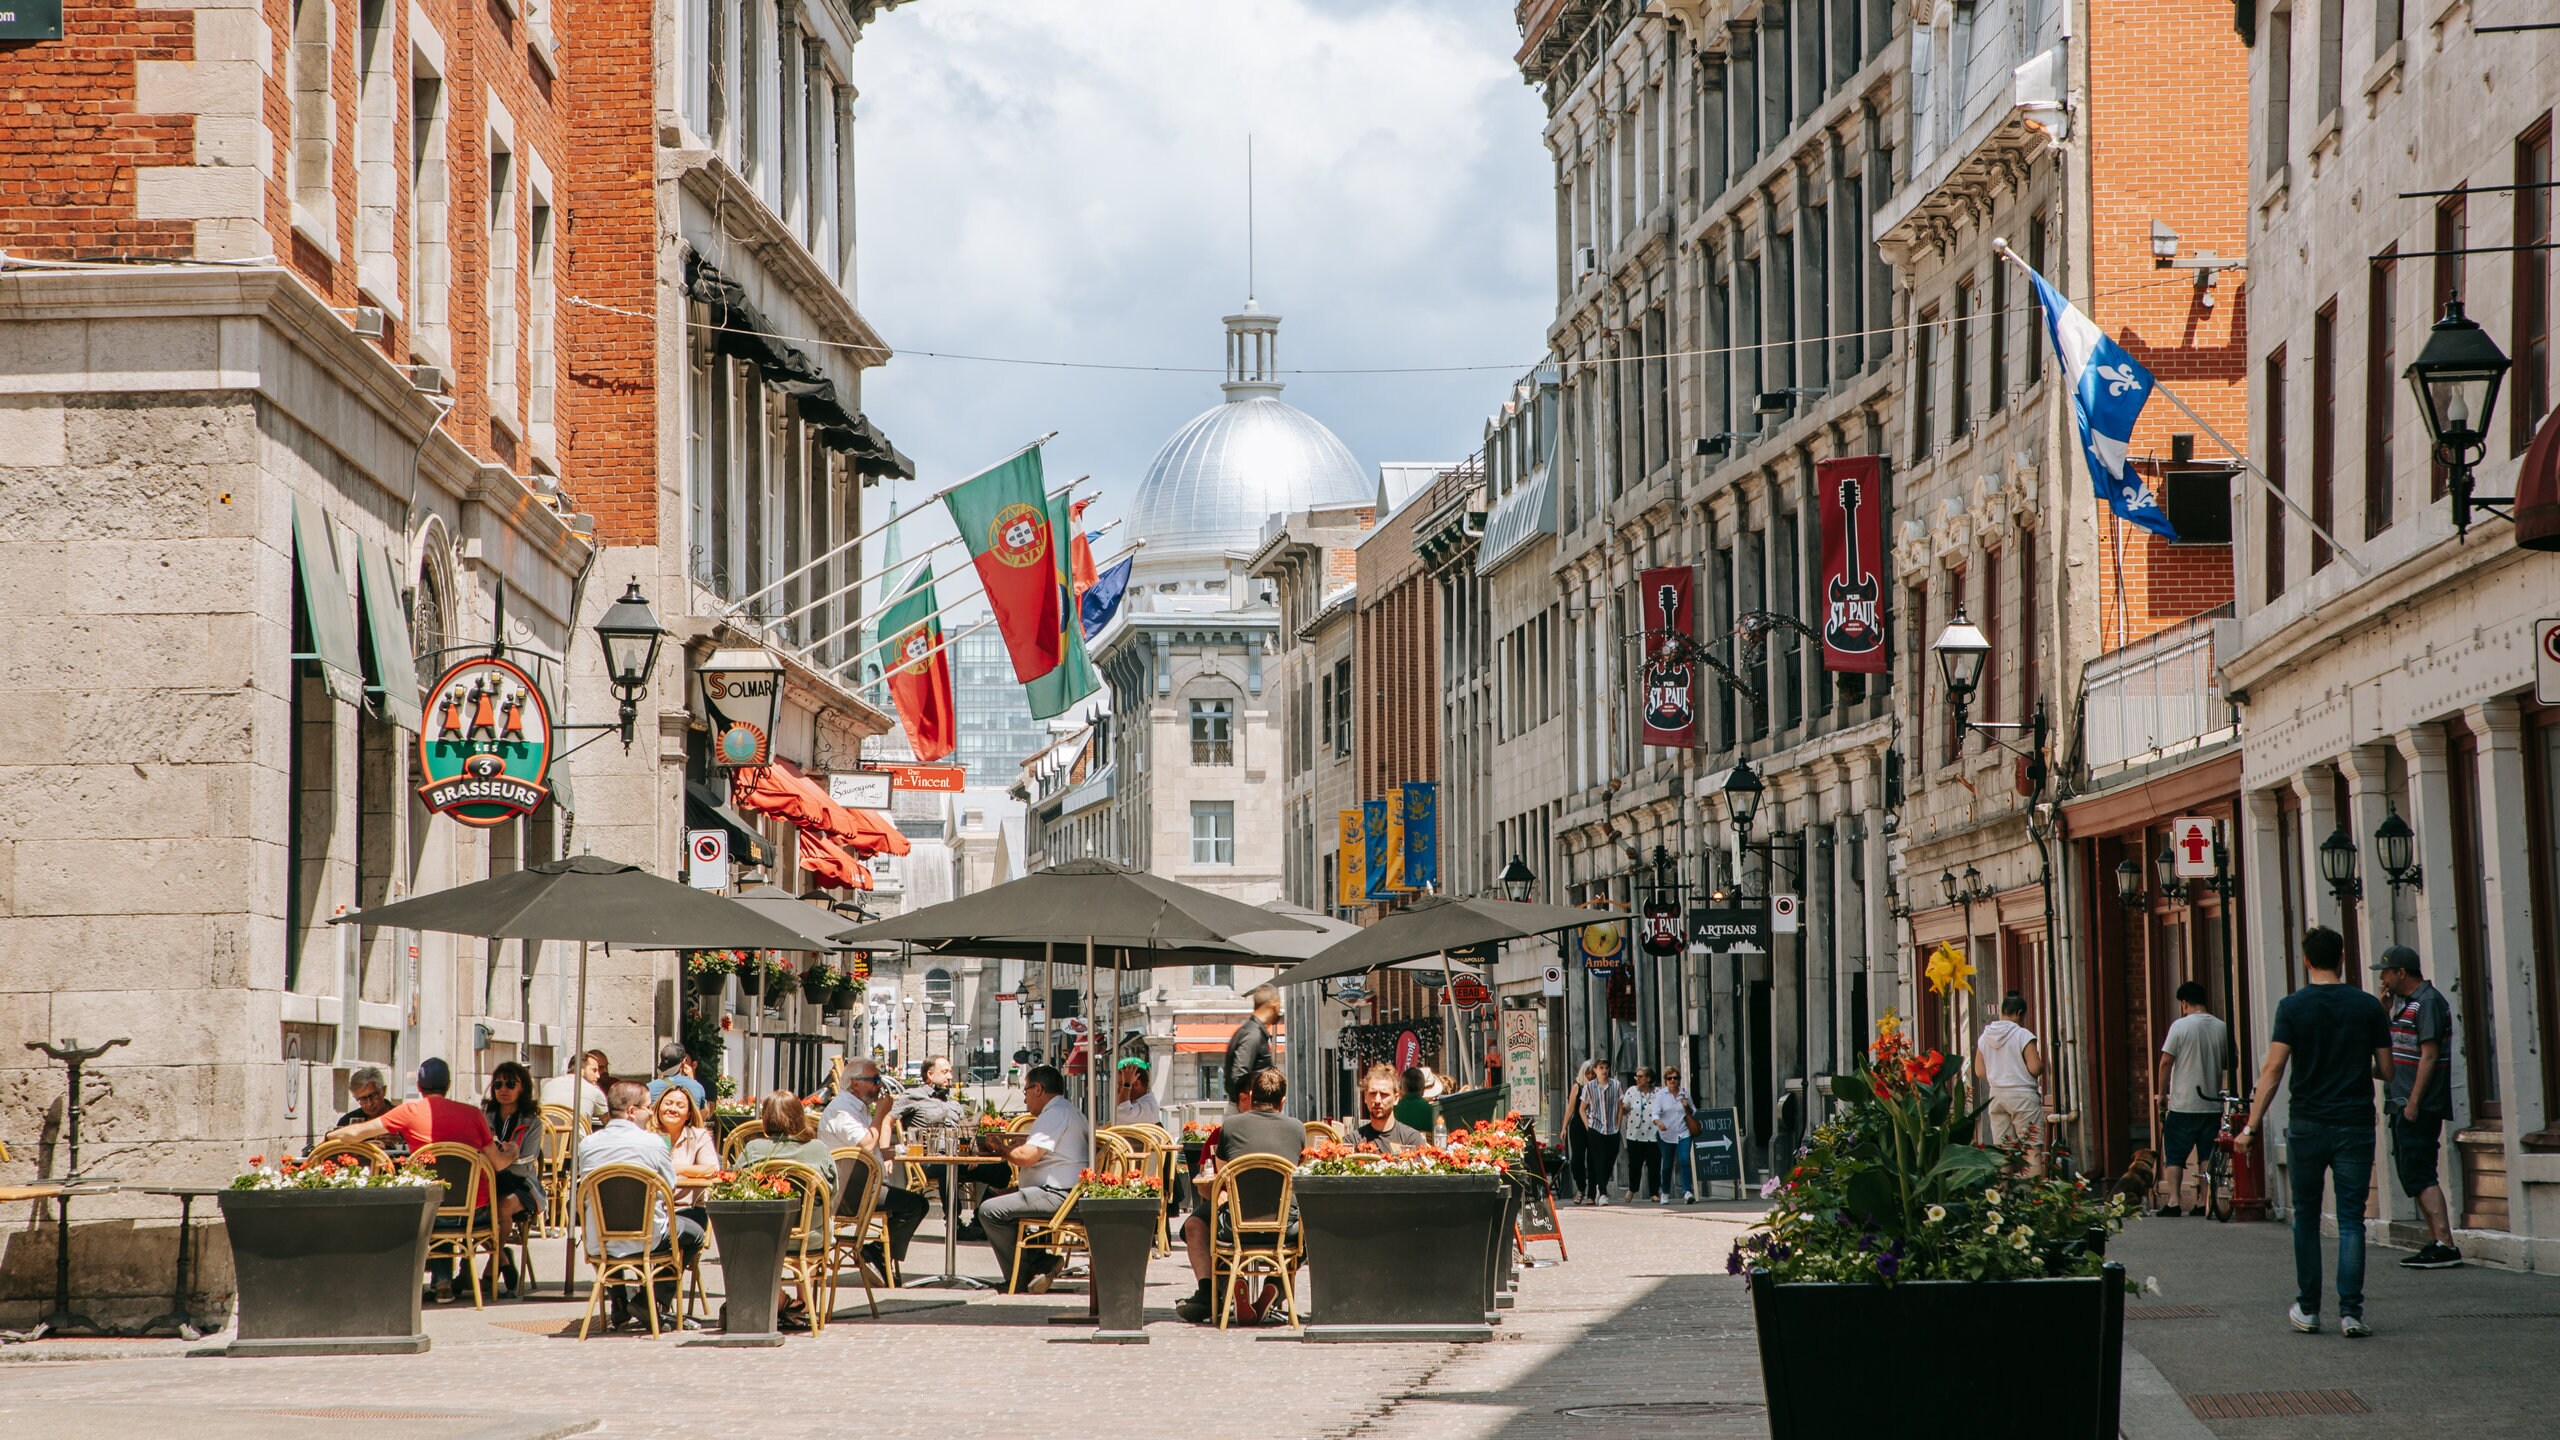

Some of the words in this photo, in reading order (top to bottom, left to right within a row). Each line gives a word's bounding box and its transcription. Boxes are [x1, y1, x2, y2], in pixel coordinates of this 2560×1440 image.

[1830, 601, 1846, 635] ST.
[1849, 600, 1878, 636] PAUL
[709, 671, 772, 700] SOLMAR
[1649, 687, 1663, 716] ST.
[1664, 686, 1689, 716] PAUL
[475, 743, 498, 752] LES
[479, 760, 492, 775] 3
[432, 781, 537, 806] BRASSEURS
[1642, 918, 1657, 945] ST.
[1659, 918, 1683, 944] PAUL
[1698, 925, 1757, 936] ARTISANS
[1585, 957, 1620, 968] Amber
